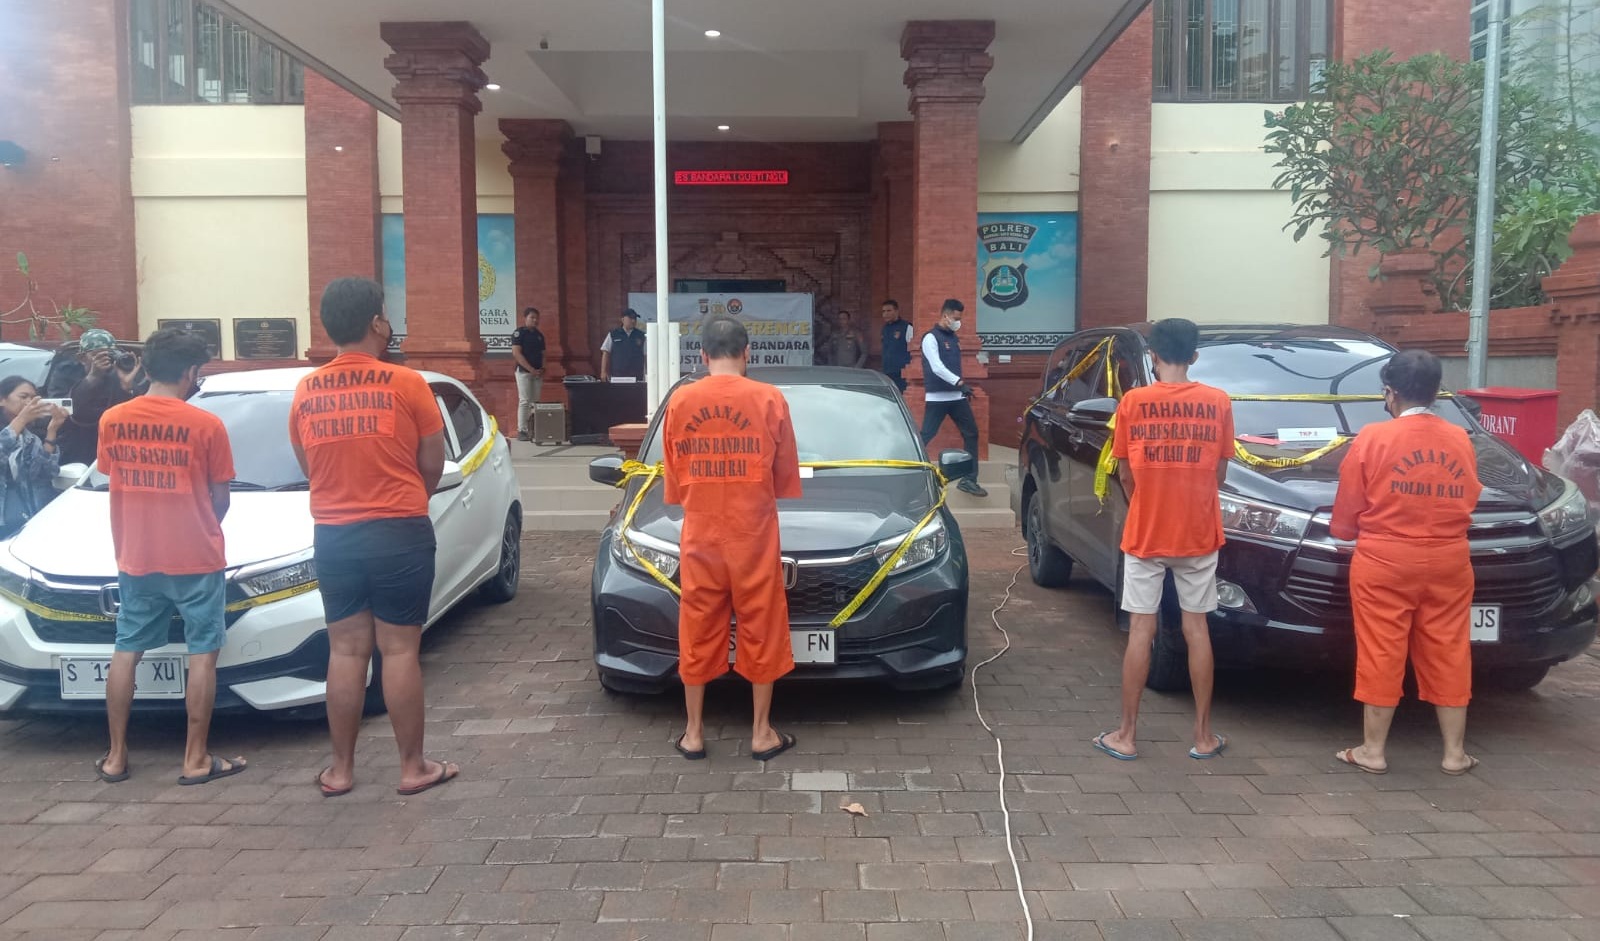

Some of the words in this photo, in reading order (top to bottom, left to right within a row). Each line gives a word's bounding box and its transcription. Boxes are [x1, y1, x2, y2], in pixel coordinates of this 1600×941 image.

[691, 173, 731, 182] BANDARA
[983, 224, 1030, 235] POLRES
[990, 242, 1022, 252] BALI
[480, 308, 508, 317] GARA
[480, 317, 509, 325] NESIA
[751, 341, 810, 350] BANDARA
[680, 355, 703, 364] STI
[764, 355, 785, 364] RAI
[304, 369, 394, 392] TAHANAN
[338, 390, 393, 412] BANDARA
[1138, 401, 1217, 420] TAHANAN
[357, 414, 379, 434] RAI
[684, 405, 752, 433] TAHANAN
[1480, 413, 1518, 436] DRANT
[109, 422, 191, 444] TAHANAN
[712, 436, 761, 455] BANDARA
[688, 459, 726, 478] GURAH
[728, 459, 746, 477] RAI
[1392, 448, 1466, 480] TAHANAN
[1390, 480, 1433, 497] POLDA
[1474, 609, 1496, 628] JS
[807, 633, 830, 652] FN
[66, 663, 78, 682] S
[152, 662, 176, 681] XU
